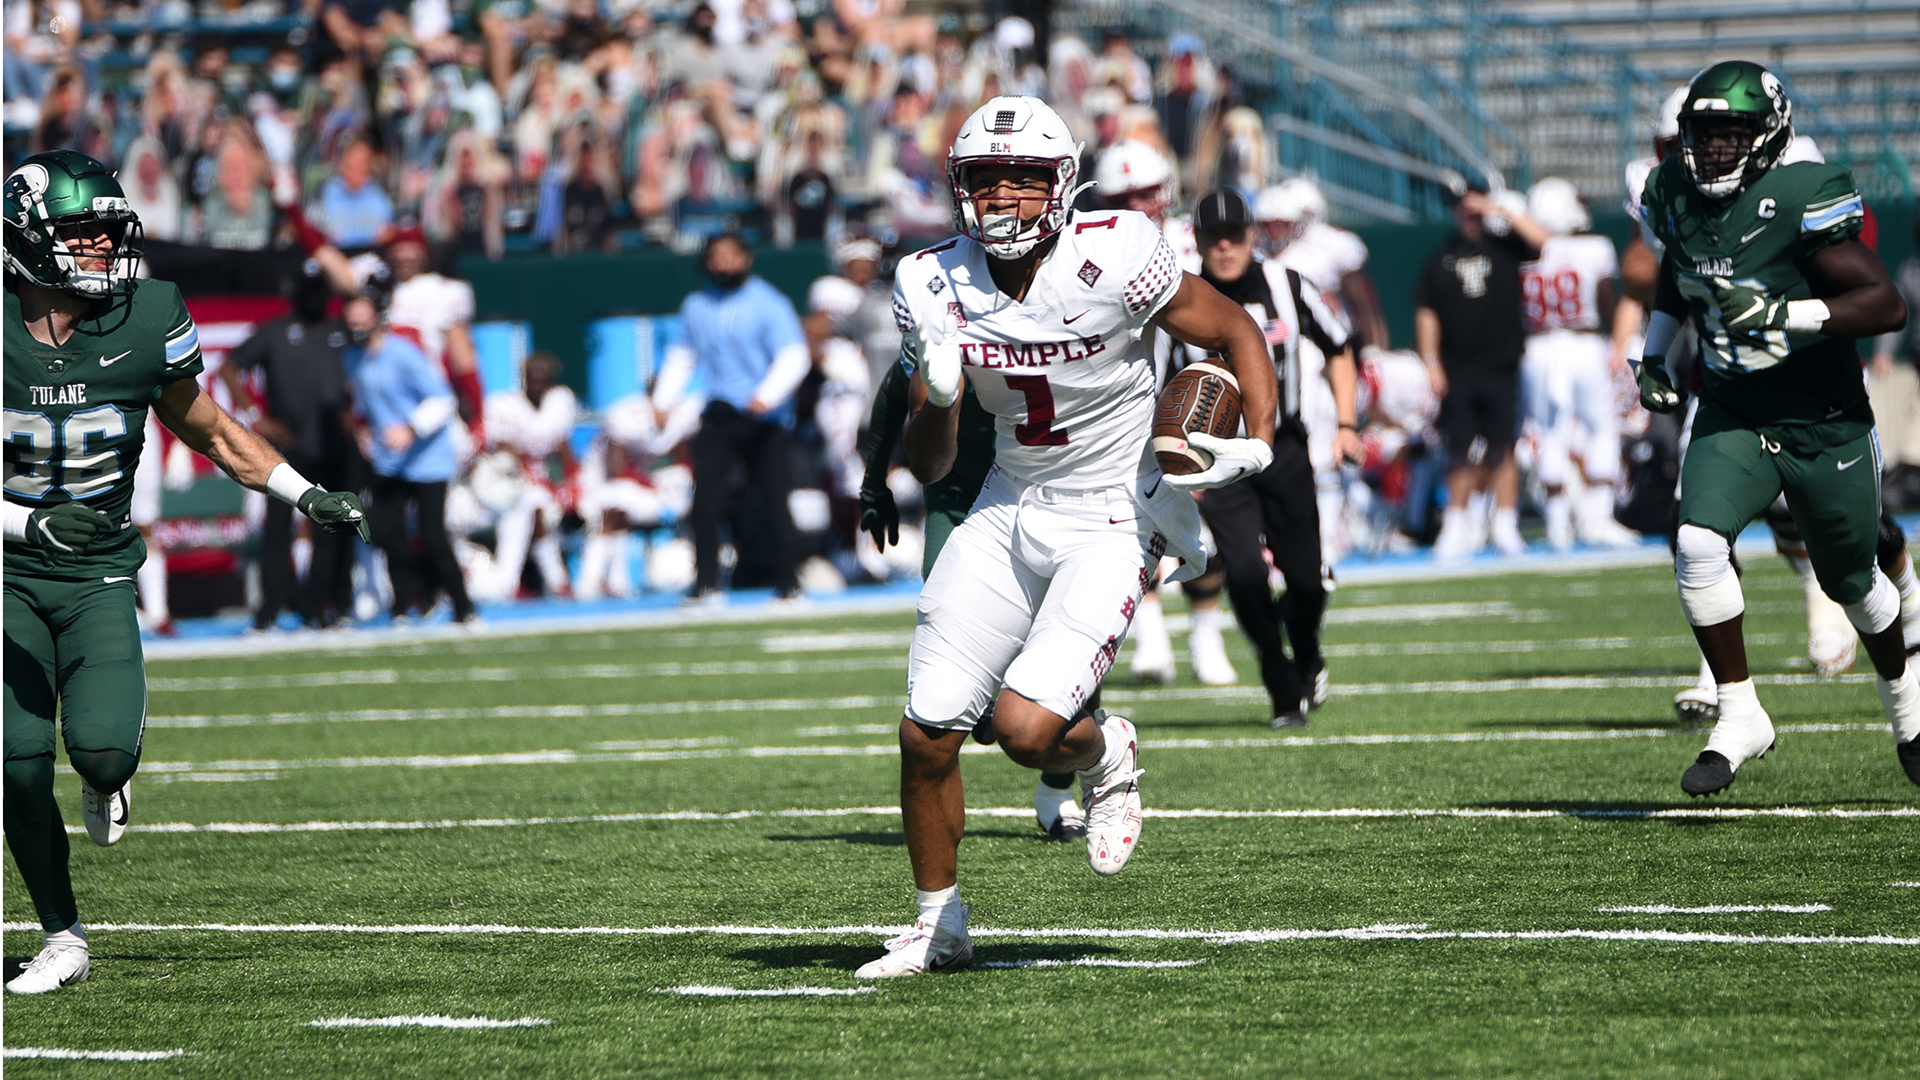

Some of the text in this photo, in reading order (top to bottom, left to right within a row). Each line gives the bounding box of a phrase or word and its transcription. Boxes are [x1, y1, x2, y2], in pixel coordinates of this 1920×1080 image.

[990, 142, 1011, 153] BLM
[1758, 197, 1776, 219] C
[1692, 256, 1734, 277] TULANE
[959, 333, 1106, 369] TEMPLE
[29, 383, 87, 406] TULANE
[1003, 374, 1070, 446] 1
[1213, 398, 1233, 436] Wilson
[3, 403, 127, 500] 36
